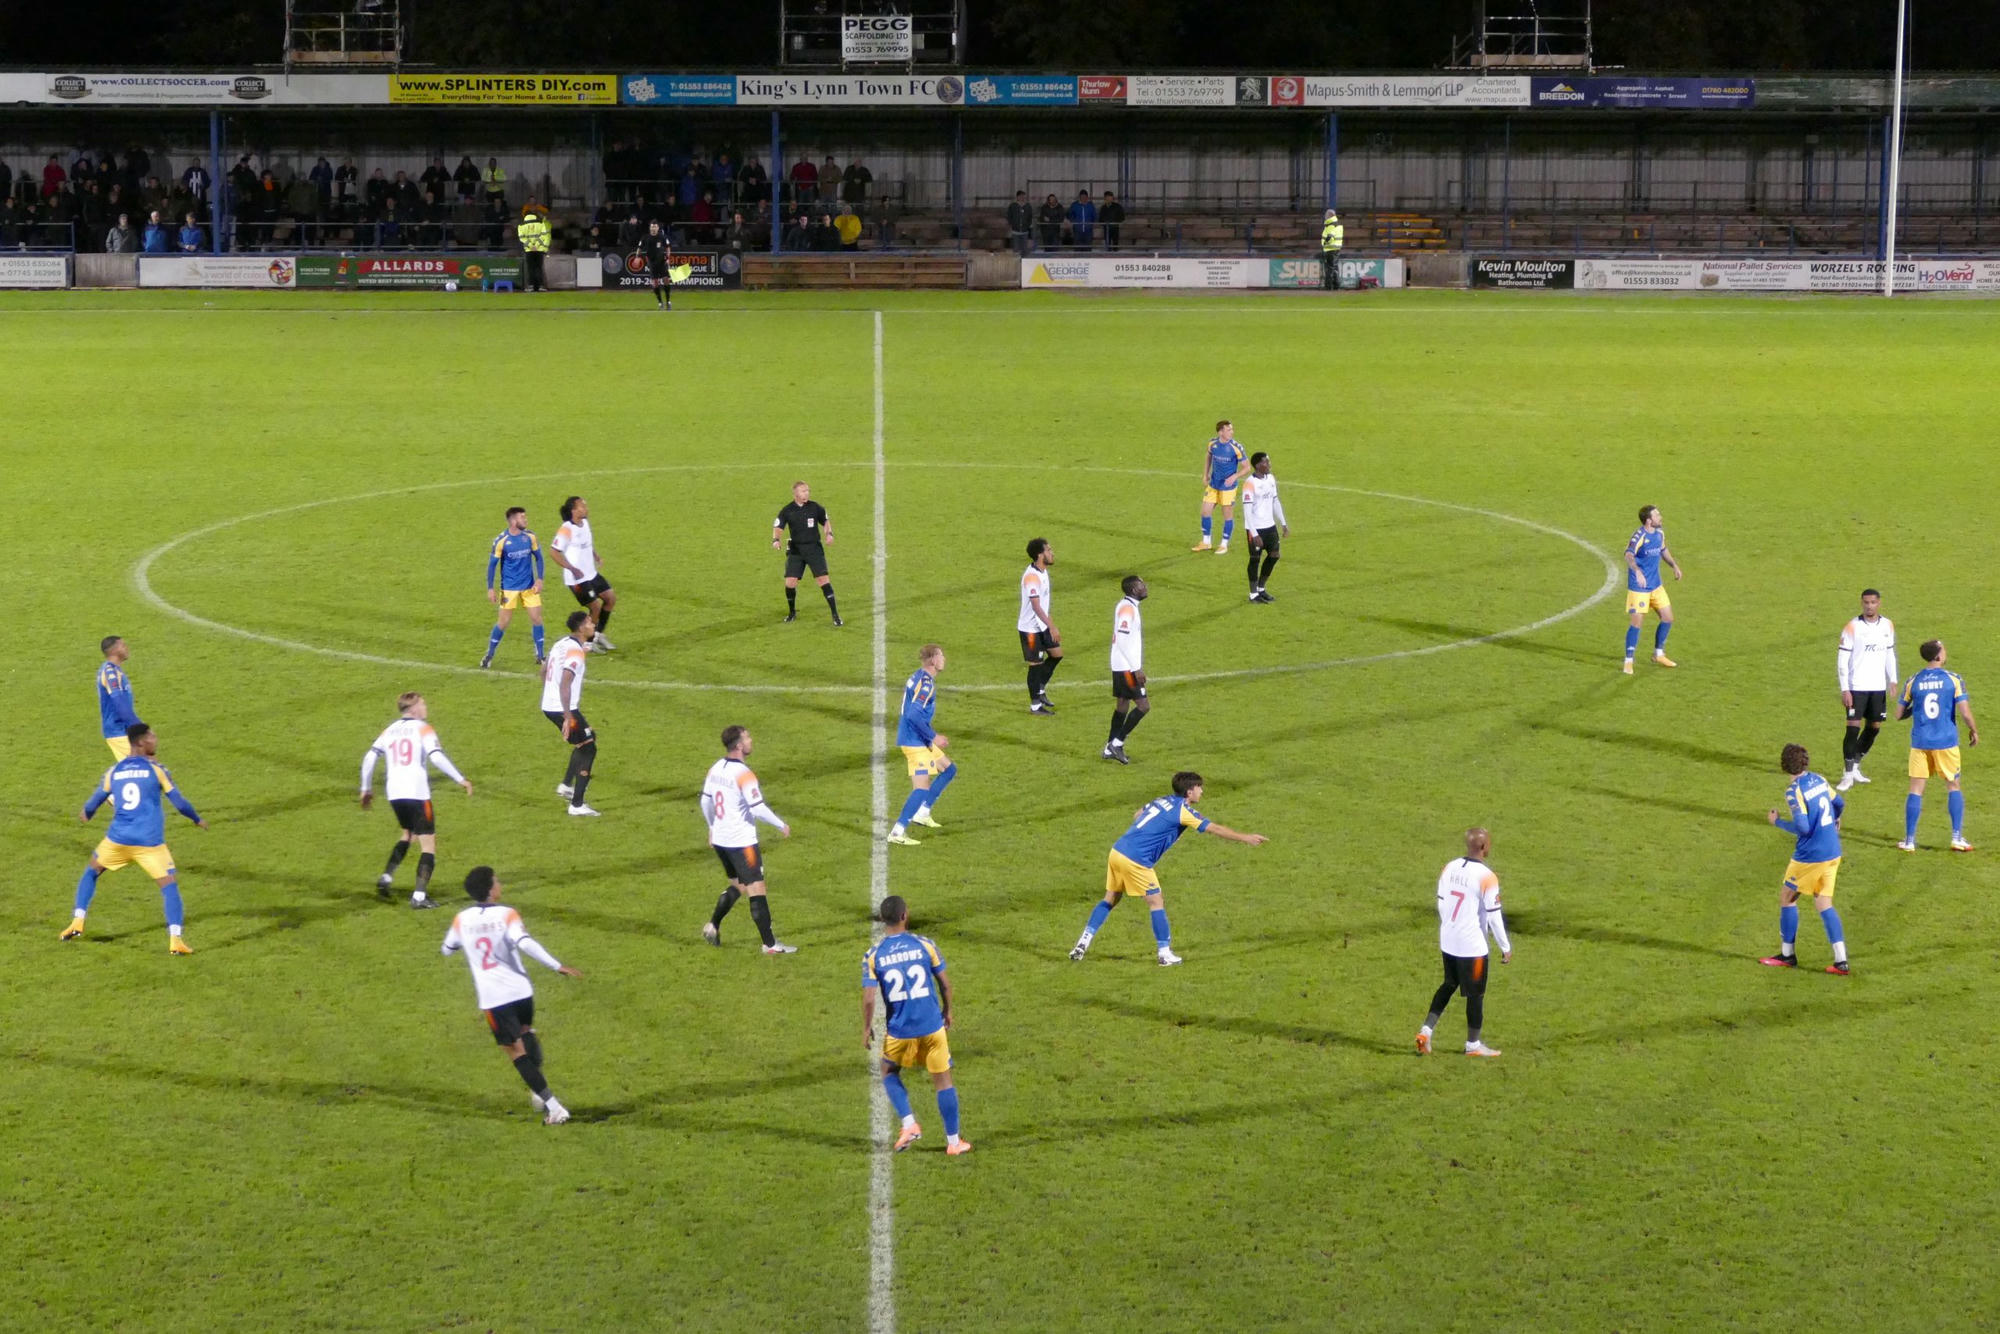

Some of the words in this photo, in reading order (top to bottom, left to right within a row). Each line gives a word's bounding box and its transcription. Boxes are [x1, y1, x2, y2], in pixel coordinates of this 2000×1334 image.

[845, 19, 908, 31] PEGG
[91, 78, 230, 86] www.COLLECTSOCCER.com
[400, 80, 536, 91] www.SPLINTERS
[542, 80, 606, 91] DIY.com
[1082, 80, 1111, 88] Thurlow
[1476, 78, 1516, 86] Chartered
[741, 80, 797, 98] King's
[804, 80, 847, 98] Lynn
[855, 80, 902, 96] Town
[910, 80, 936, 96] FC
[1154, 88, 1185, 96] 01553
[1188, 88, 1224, 96] 769799
[1306, 84, 1379, 100] Mapus-Smith
[1382, 84, 1390, 97] &
[1393, 84, 1442, 97] Lemmon
[1445, 84, 1464, 96] LLP
[1464, 96, 1528, 104] www.mapus.co.uk
[1540, 92, 1584, 100] BREEDON
[372, 261, 445, 271] ALLARDS
[1049, 267, 1089, 275] GEORGE
[1115, 264, 1140, 272] 01553
[1142, 264, 1171, 272] 840288
[1279, 261, 1376, 279] SUBAY
[1478, 260, 1511, 272] Kevin
[1514, 260, 1566, 272] Moulton
[1702, 262, 1737, 270] National
[1739, 262, 1764, 270] Pallet
[1765, 262, 1802, 271] Services
[1810, 264, 1864, 273] WORZEL'S
[1623, 277, 1648, 285] 01553
[1650, 277, 1679, 285] 833032
[1920, 269, 1975, 284] H2OVend
[1924, 693, 1940, 720] 6
[388, 738, 413, 766] 19
[122, 782, 141, 811] 9
[715, 790, 724, 820] 8
[1819, 796, 1833, 826] 2
[1450, 874, 1468, 888] HALL
[1450, 890, 1465, 922] 7
[475, 937, 498, 970] 2
[879, 949, 924, 967] BARROWS
[884, 964, 930, 1003] 22
